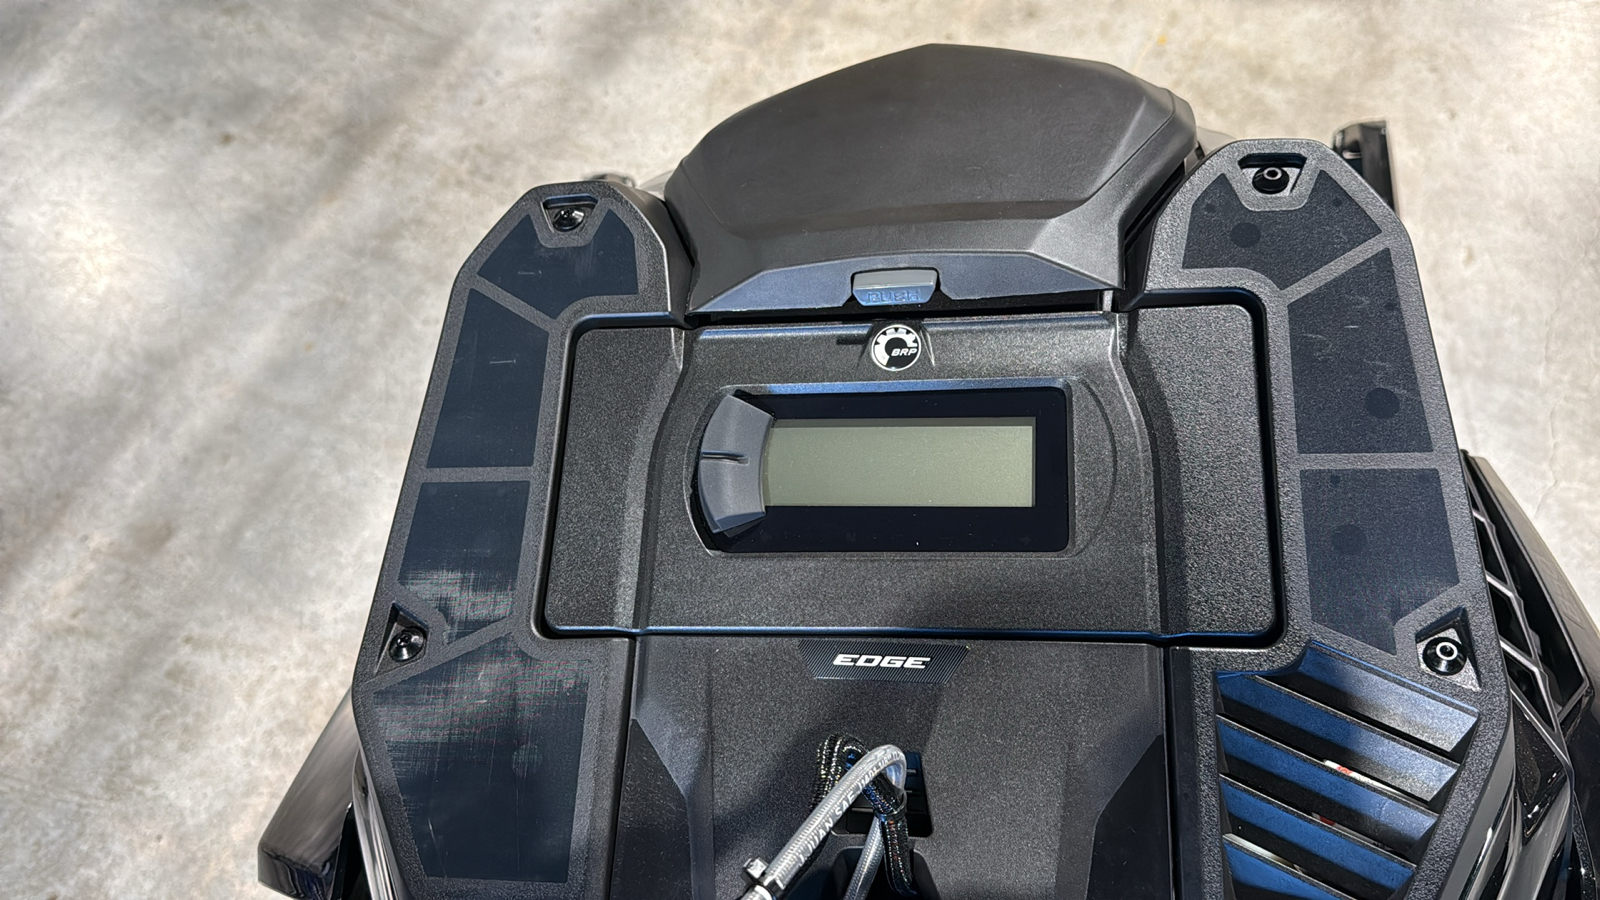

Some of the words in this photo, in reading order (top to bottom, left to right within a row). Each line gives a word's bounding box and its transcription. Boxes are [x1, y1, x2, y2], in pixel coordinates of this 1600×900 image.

[867, 290, 920, 302] PUSH
[891, 348, 918, 356] BRP
[832, 653, 931, 669] EDGE
[835, 792, 858, 817] SAE
